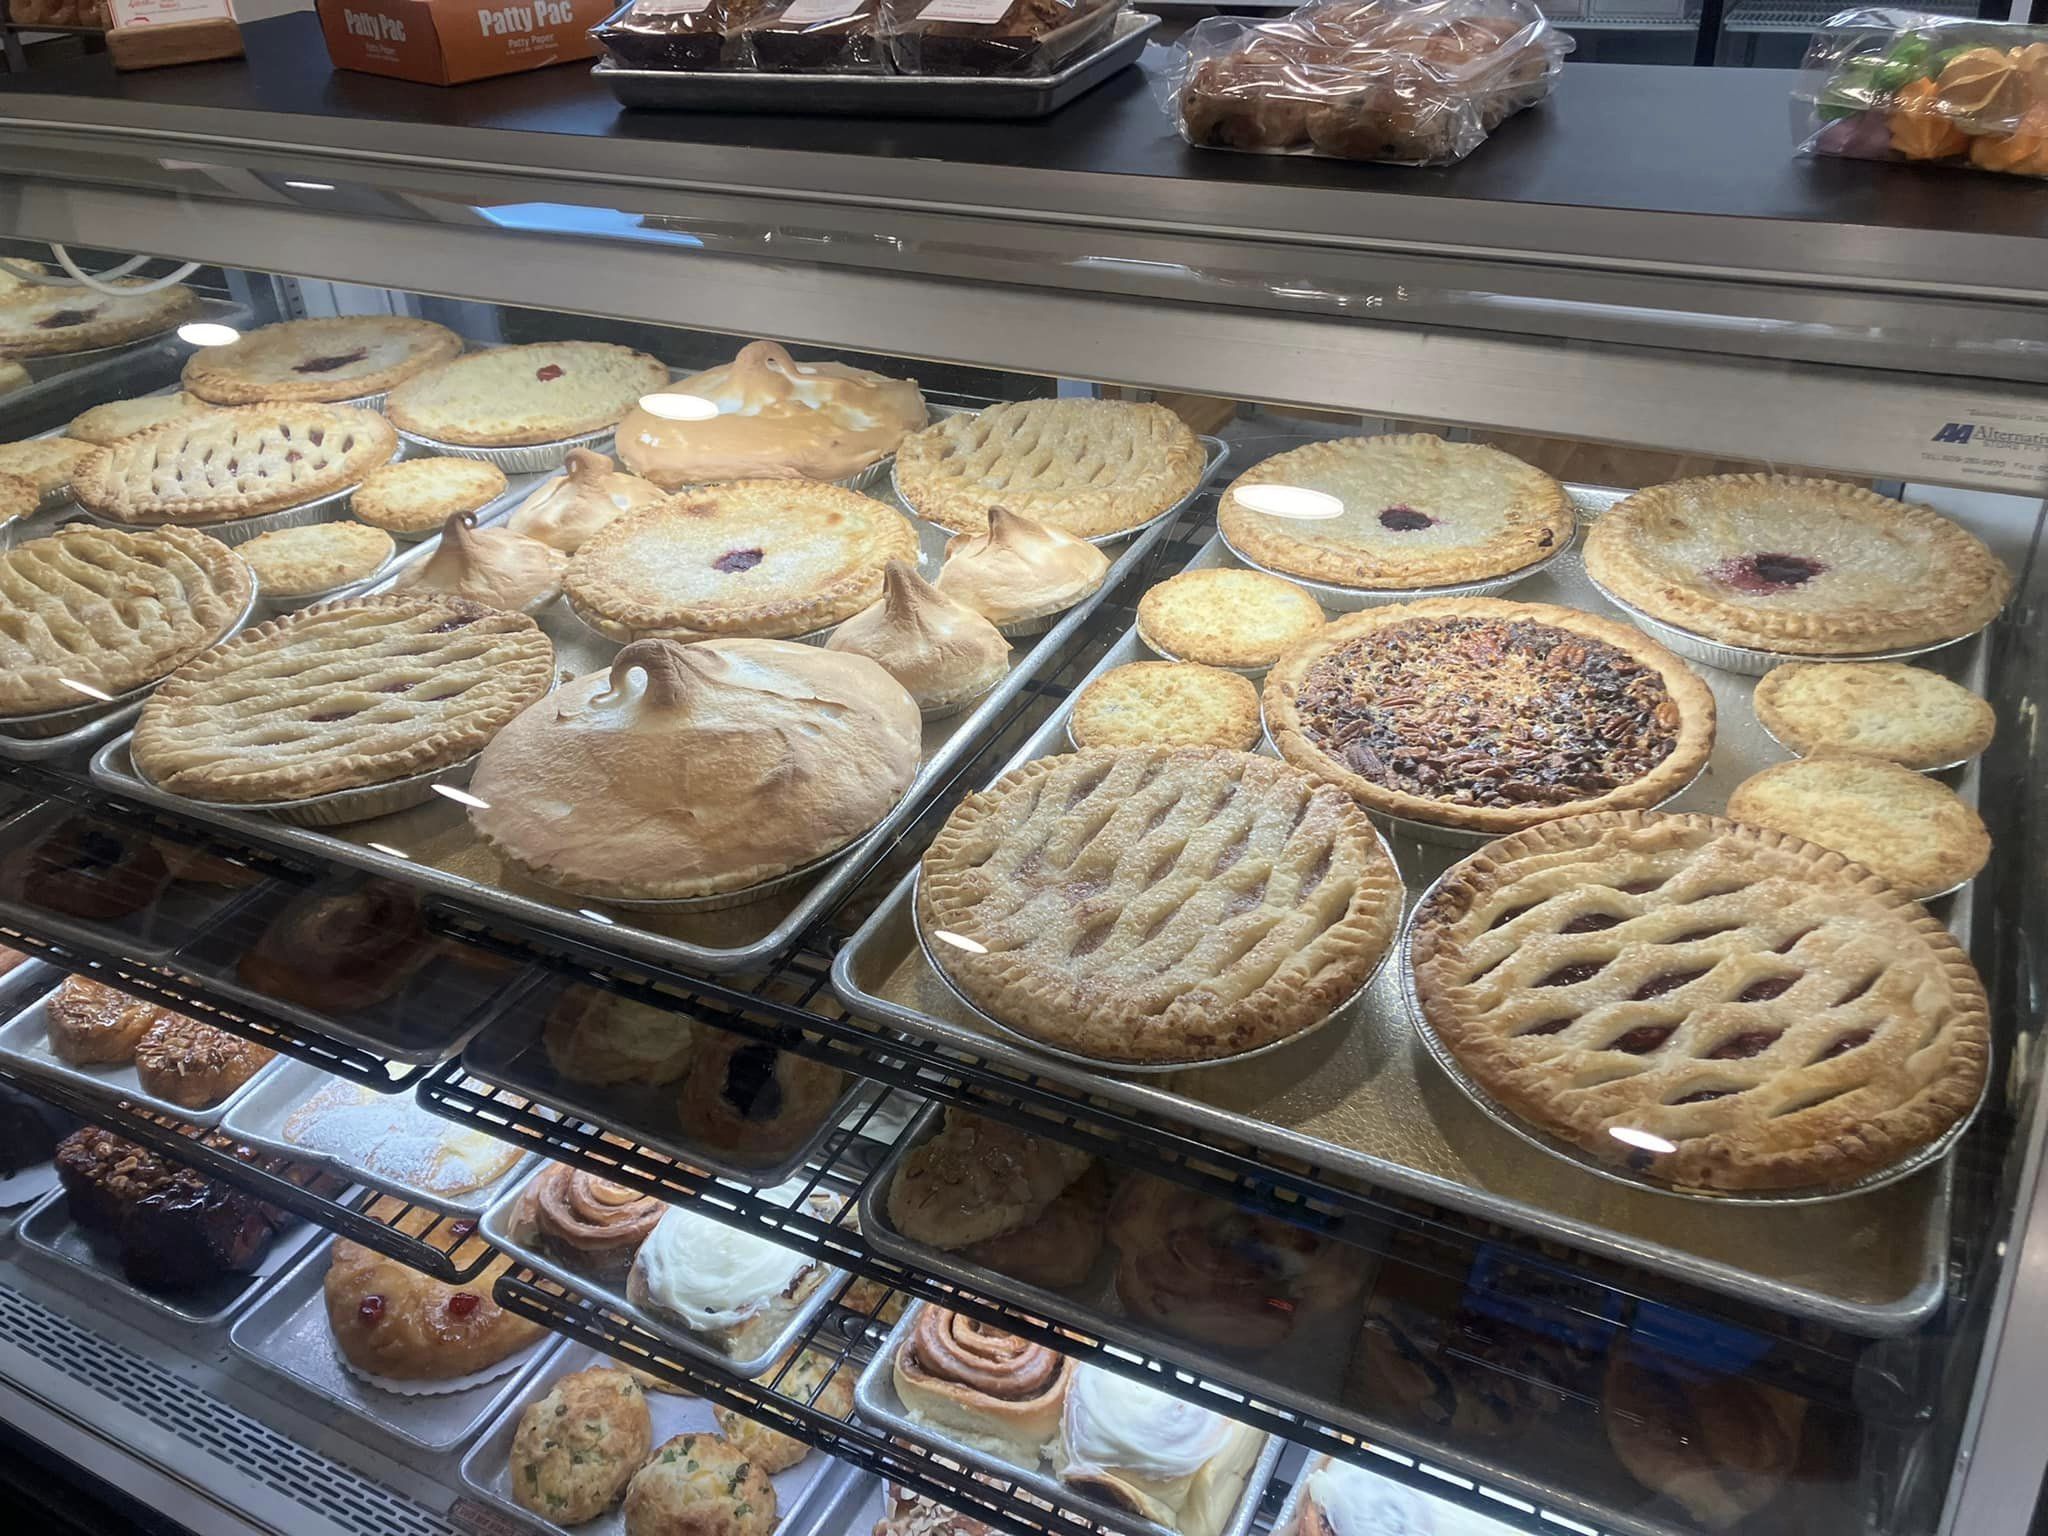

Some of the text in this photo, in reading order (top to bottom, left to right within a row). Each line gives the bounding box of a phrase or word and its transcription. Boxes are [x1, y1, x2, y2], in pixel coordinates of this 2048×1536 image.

[344, 8, 406, 42] Patty Pac
[478, 0, 573, 37] Patty Pac
[1974, 425, 2048, 444] Alternati
